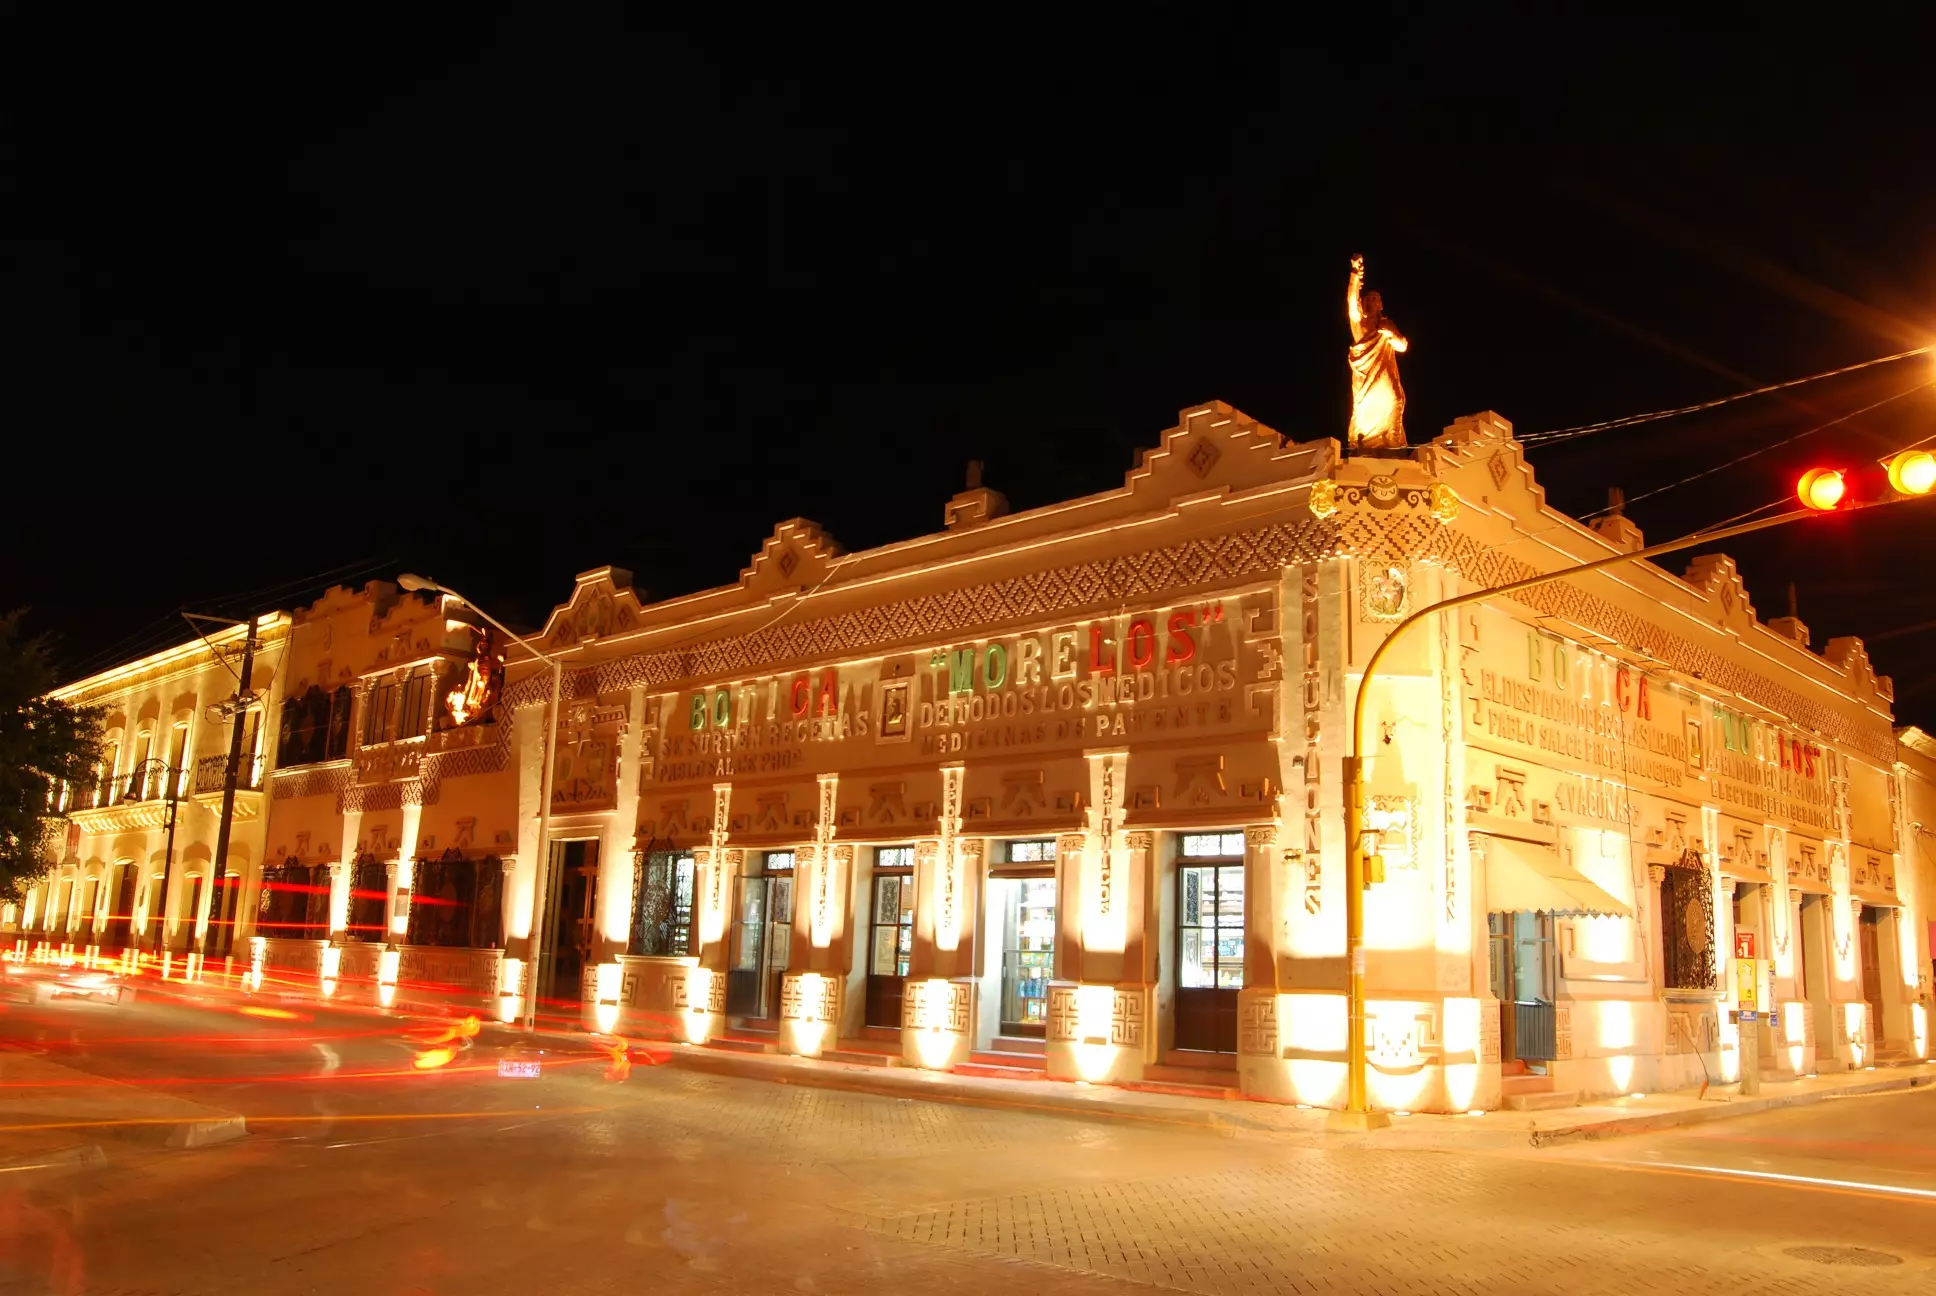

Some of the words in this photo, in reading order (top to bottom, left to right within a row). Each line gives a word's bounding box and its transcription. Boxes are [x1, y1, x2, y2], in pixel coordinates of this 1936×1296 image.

[690, 671, 838, 731] BOTICA
[920, 701, 949, 727] DE
[950, 692, 1034, 725] TODOS
[1041, 681, 1092, 712] LOS
[1096, 659, 1236, 706] MEDICOS
[1526, 630, 1652, 720] BOTICA
[687, 723, 762, 757] SURTEN
[769, 711, 868, 747] RECETAS
[922, 721, 1047, 753] MEDICINAS
[1056, 718, 1087, 738] DE
[1096, 699, 1232, 736] PATENTE
[1302, 573, 1321, 915] SOLUCIONES
[1488, 708, 1535, 745] PABLO
[1567, 783, 1630, 825] VACUNAS
